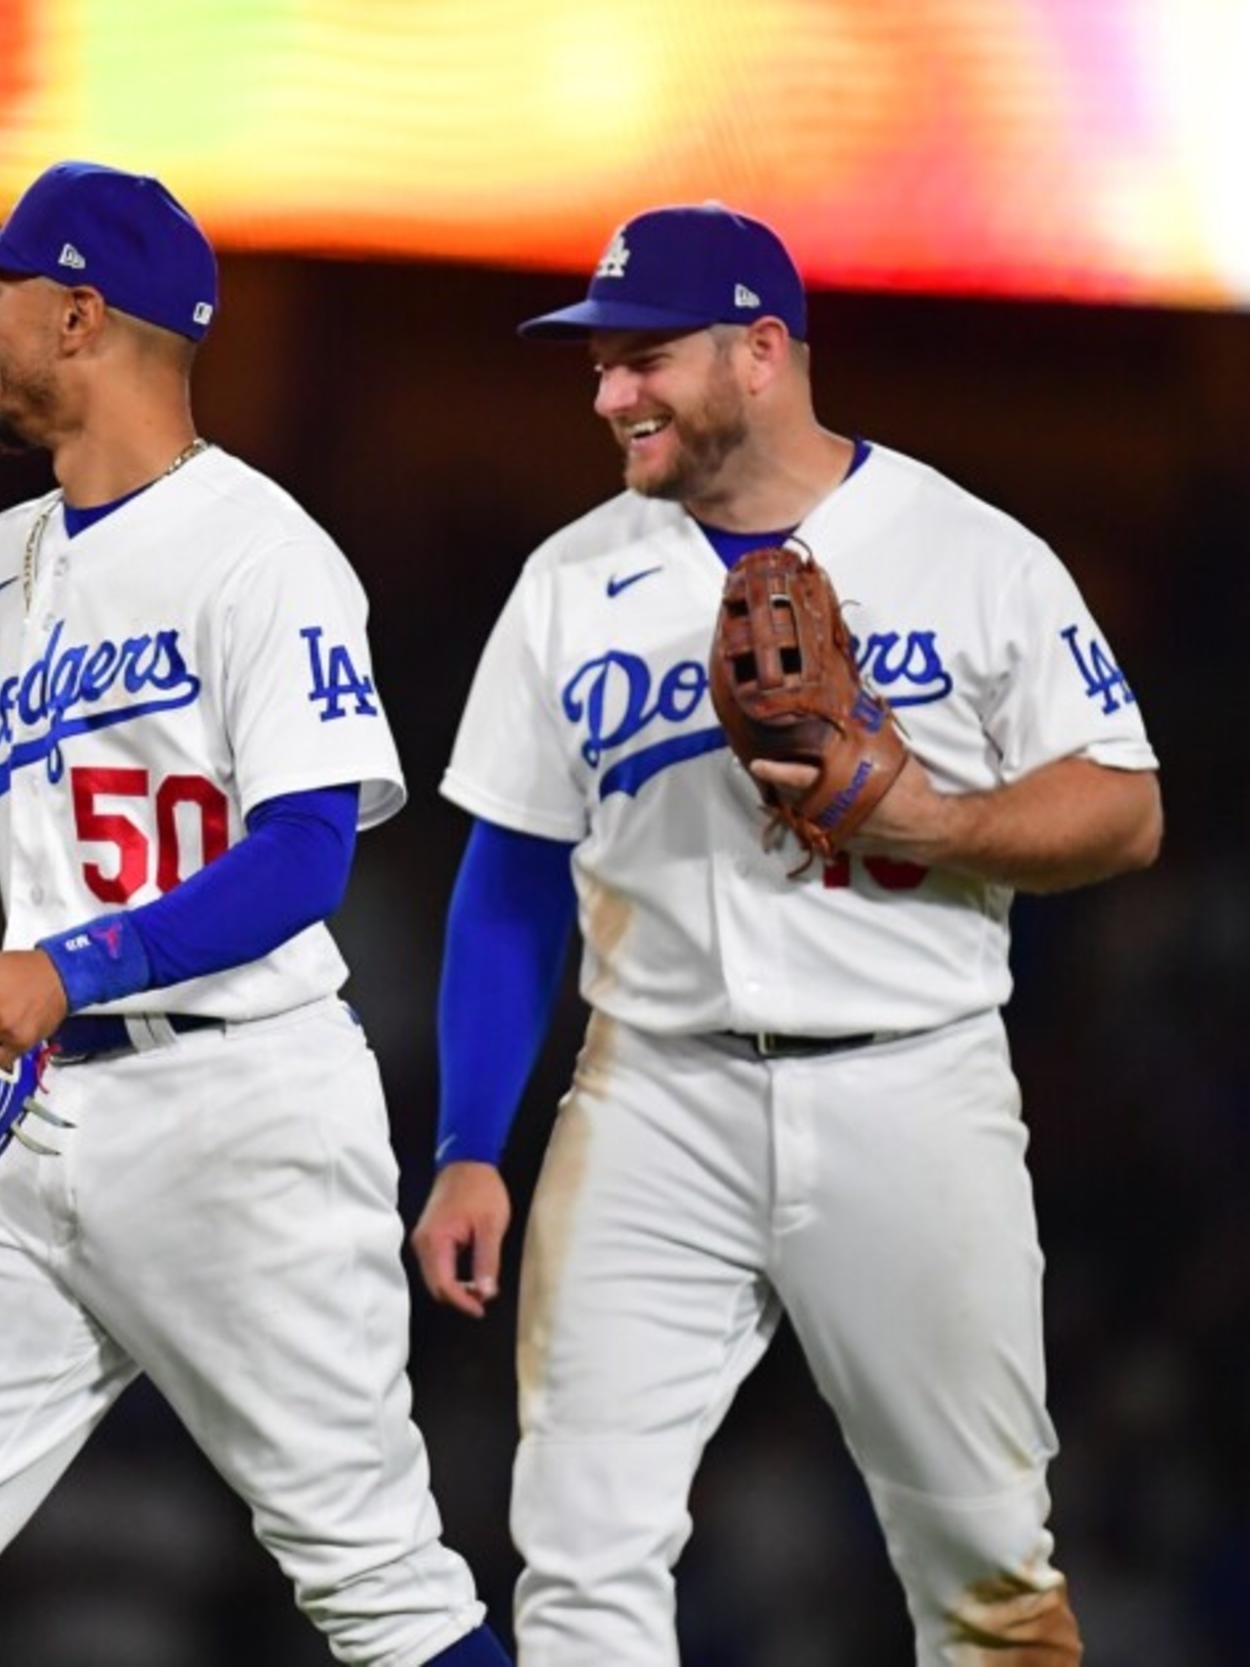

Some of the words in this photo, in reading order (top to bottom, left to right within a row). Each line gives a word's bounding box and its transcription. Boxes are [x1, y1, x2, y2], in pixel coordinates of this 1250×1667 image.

[299, 626, 378, 723] LA
[562, 630, 950, 769] Dors
[1060, 625, 1135, 715] LA
[70, 767, 229, 905] 50
